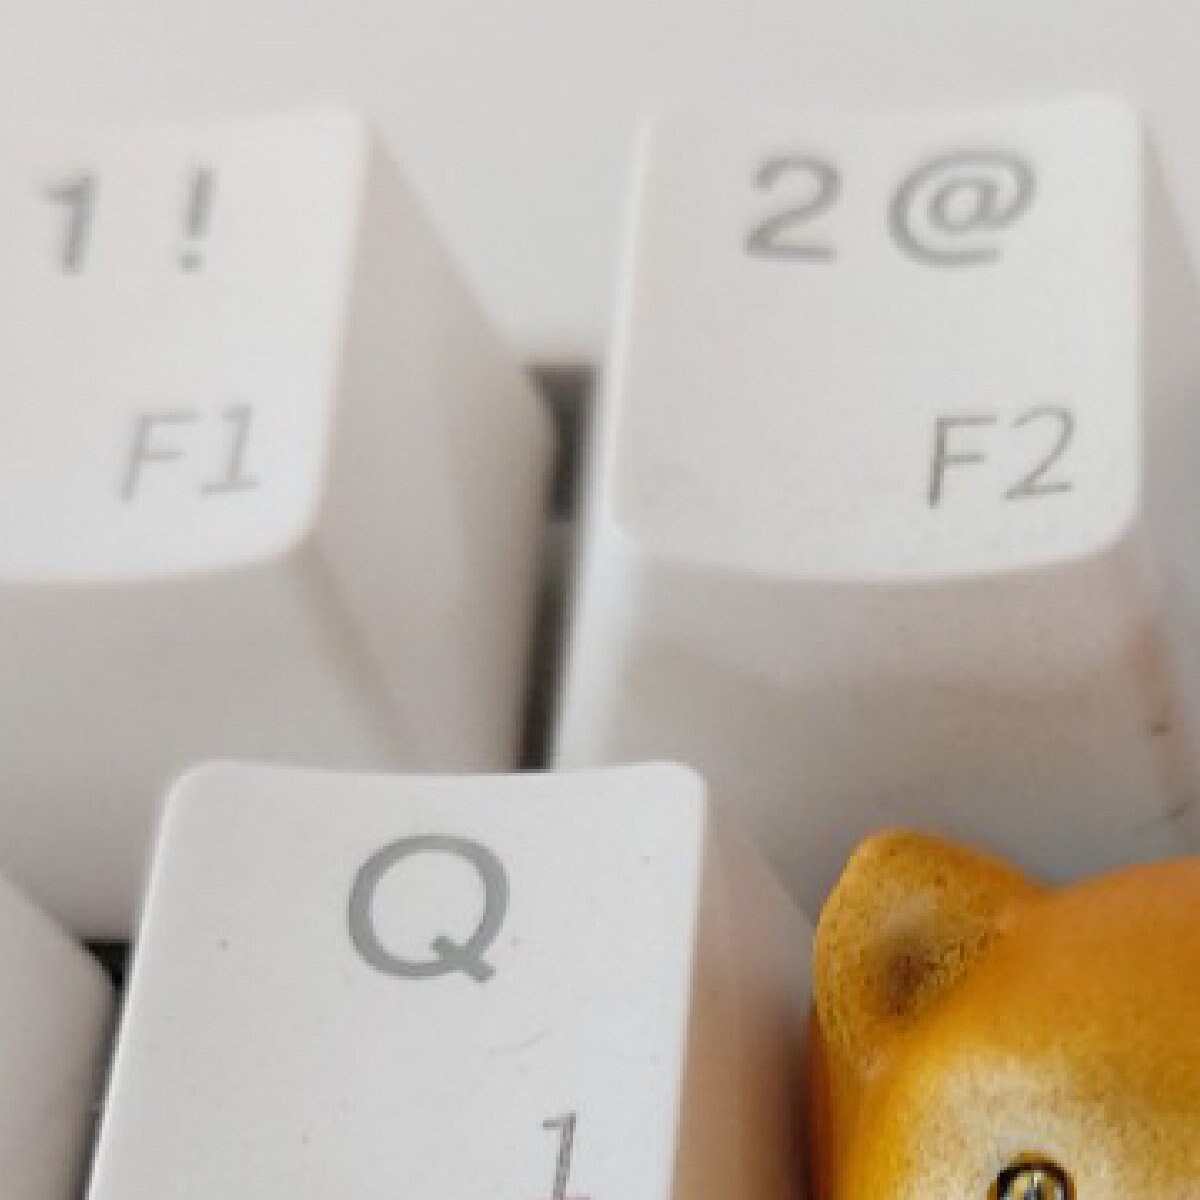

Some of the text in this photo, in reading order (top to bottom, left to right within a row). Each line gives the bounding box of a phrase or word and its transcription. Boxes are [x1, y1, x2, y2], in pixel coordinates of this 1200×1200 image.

[117, 404, 260, 502] F1
[927, 405, 1075, 508] F2
[347, 833, 510, 983] Q
